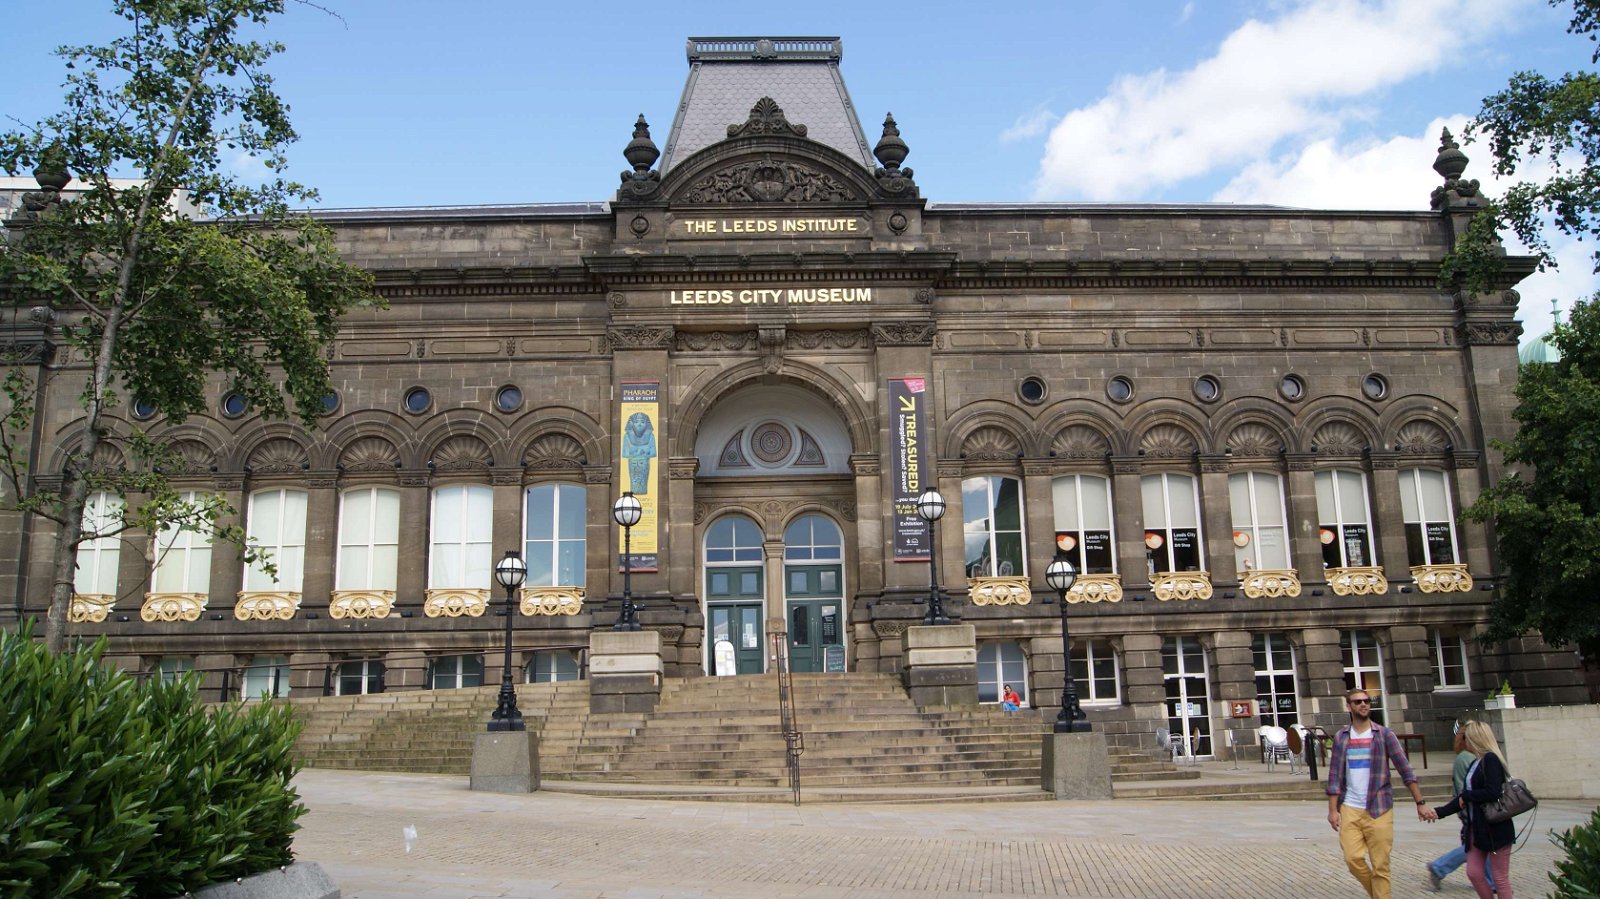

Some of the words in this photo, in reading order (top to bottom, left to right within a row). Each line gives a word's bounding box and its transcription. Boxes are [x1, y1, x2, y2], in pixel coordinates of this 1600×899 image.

[685, 220, 717, 233] THE
[722, 220, 777, 233] LEEDS
[782, 219, 857, 232] INSTITUTE
[670, 290, 733, 305] LEEDS
[739, 290, 782, 304] CITY
[787, 288, 872, 303] MUSEUM
[906, 413, 919, 493] TREASURED!
